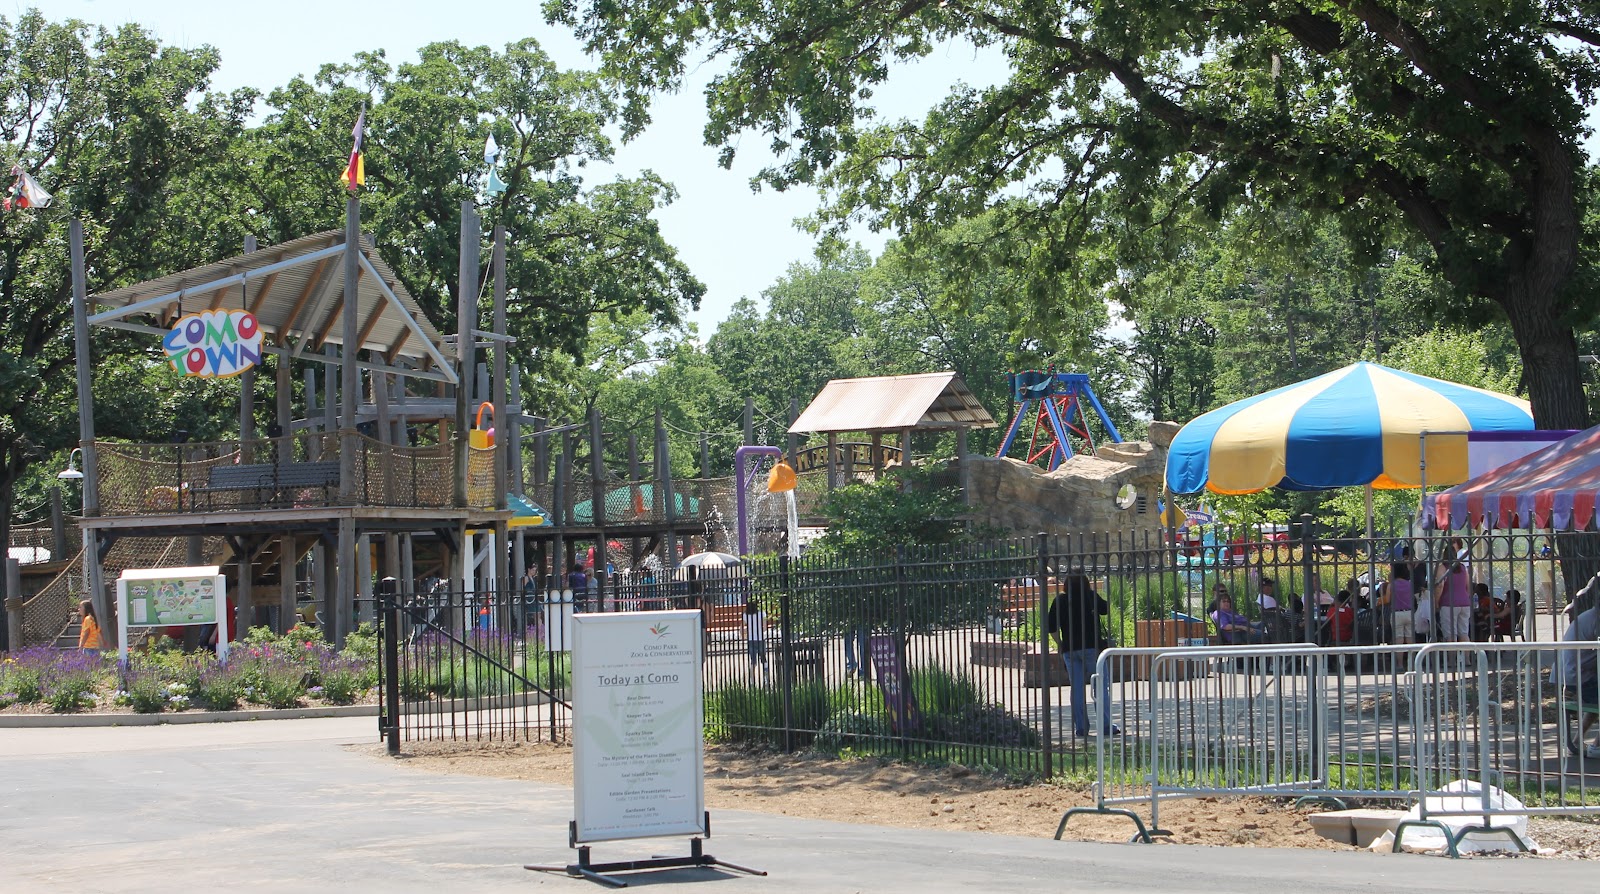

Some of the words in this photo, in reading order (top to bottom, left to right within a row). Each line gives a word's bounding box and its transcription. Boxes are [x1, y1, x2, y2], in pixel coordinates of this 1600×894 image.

[163, 314, 258, 351] COMO
[167, 342, 262, 377] TOWN
[1186, 511, 1208, 522] Cream
[598, 675, 631, 686] Today
[634, 675, 645, 684] at
[647, 673, 679, 683] Como
